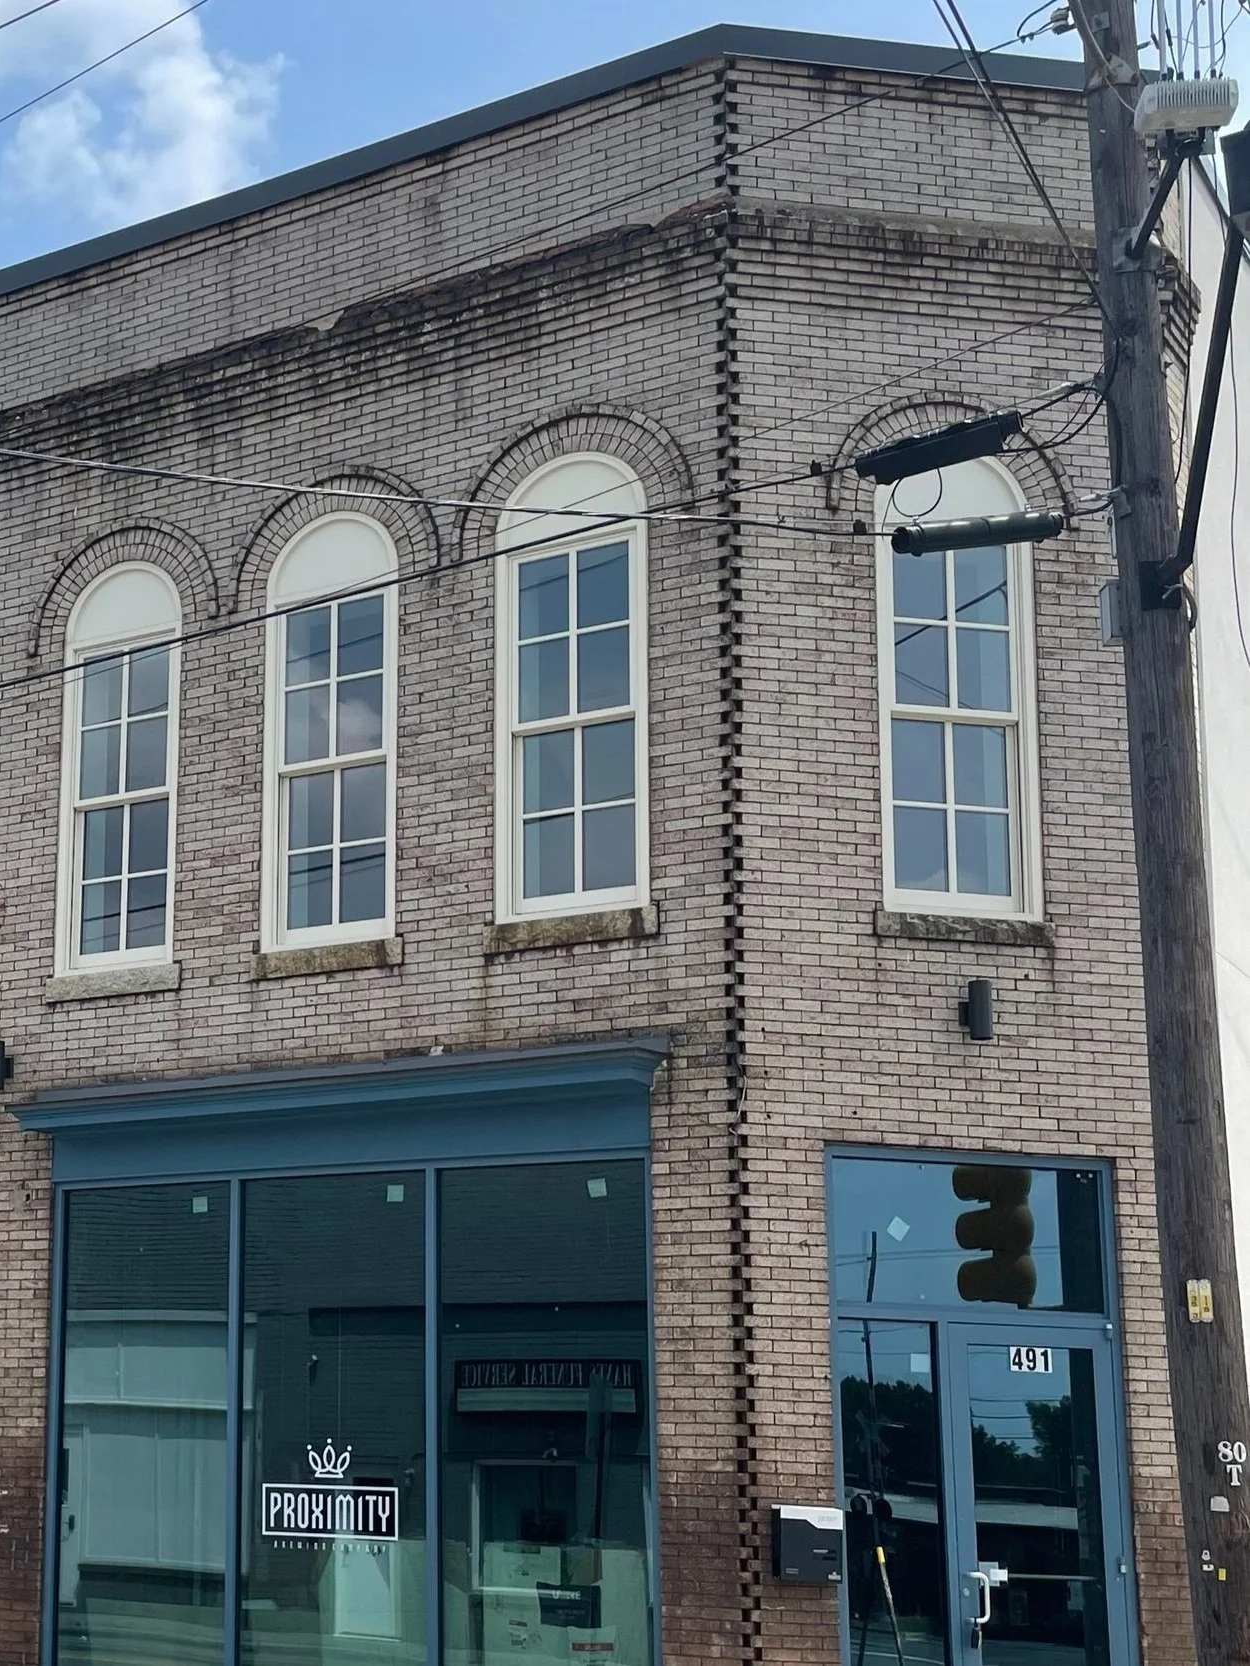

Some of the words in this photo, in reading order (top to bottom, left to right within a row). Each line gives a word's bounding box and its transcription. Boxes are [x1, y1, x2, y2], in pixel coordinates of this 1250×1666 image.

[1012, 1347, 1049, 1372] 491
[1217, 1440, 1247, 1462] 80
[1226, 1464, 1243, 1486] T
[269, 1492, 390, 1532] PROXIMITY
